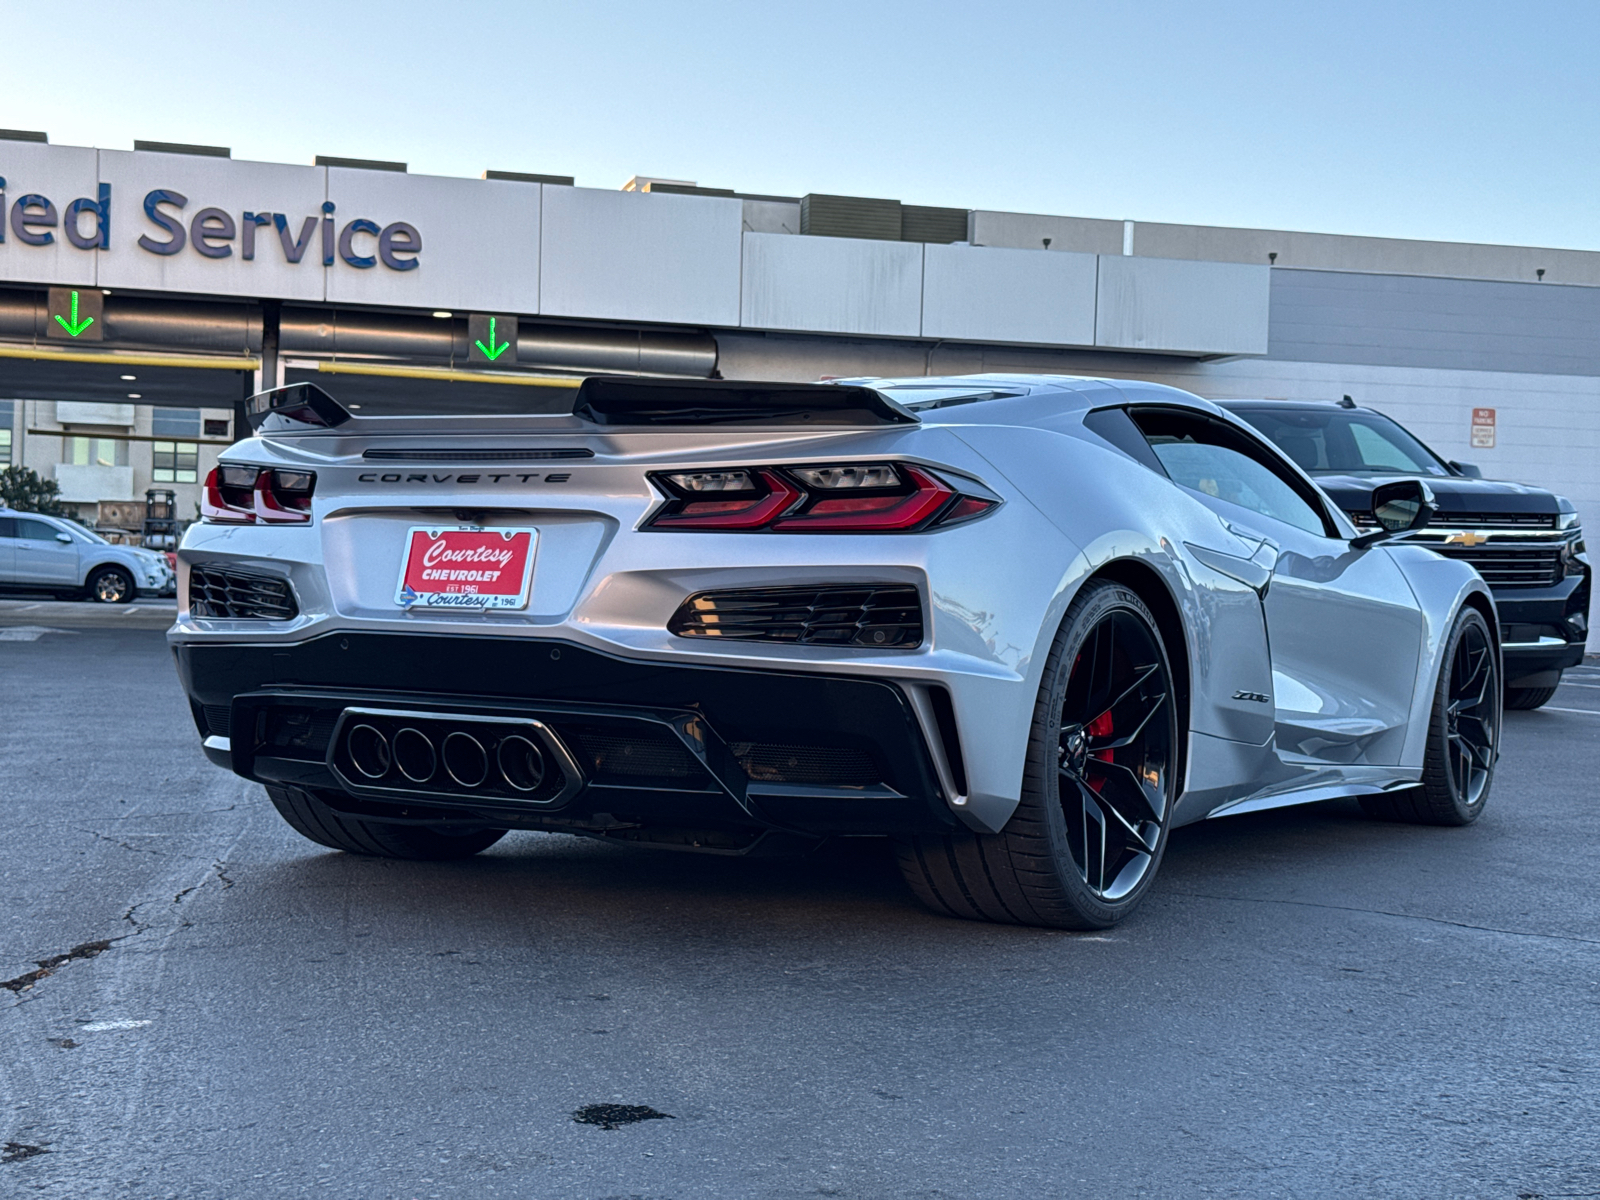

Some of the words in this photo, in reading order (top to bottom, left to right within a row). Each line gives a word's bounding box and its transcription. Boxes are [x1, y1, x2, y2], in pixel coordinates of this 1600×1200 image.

[138, 189, 422, 271] Service
[358, 473, 572, 483] CORVETTE
[423, 539, 514, 568] Courtesy
[422, 569, 501, 582] CHEVROLET
[446, 585, 459, 593] EST
[461, 585, 479, 594] 1961
[427, 592, 490, 608] Courtesy
[501, 598, 516, 606] 1961
[1231, 690, 1271, 703] Z06
